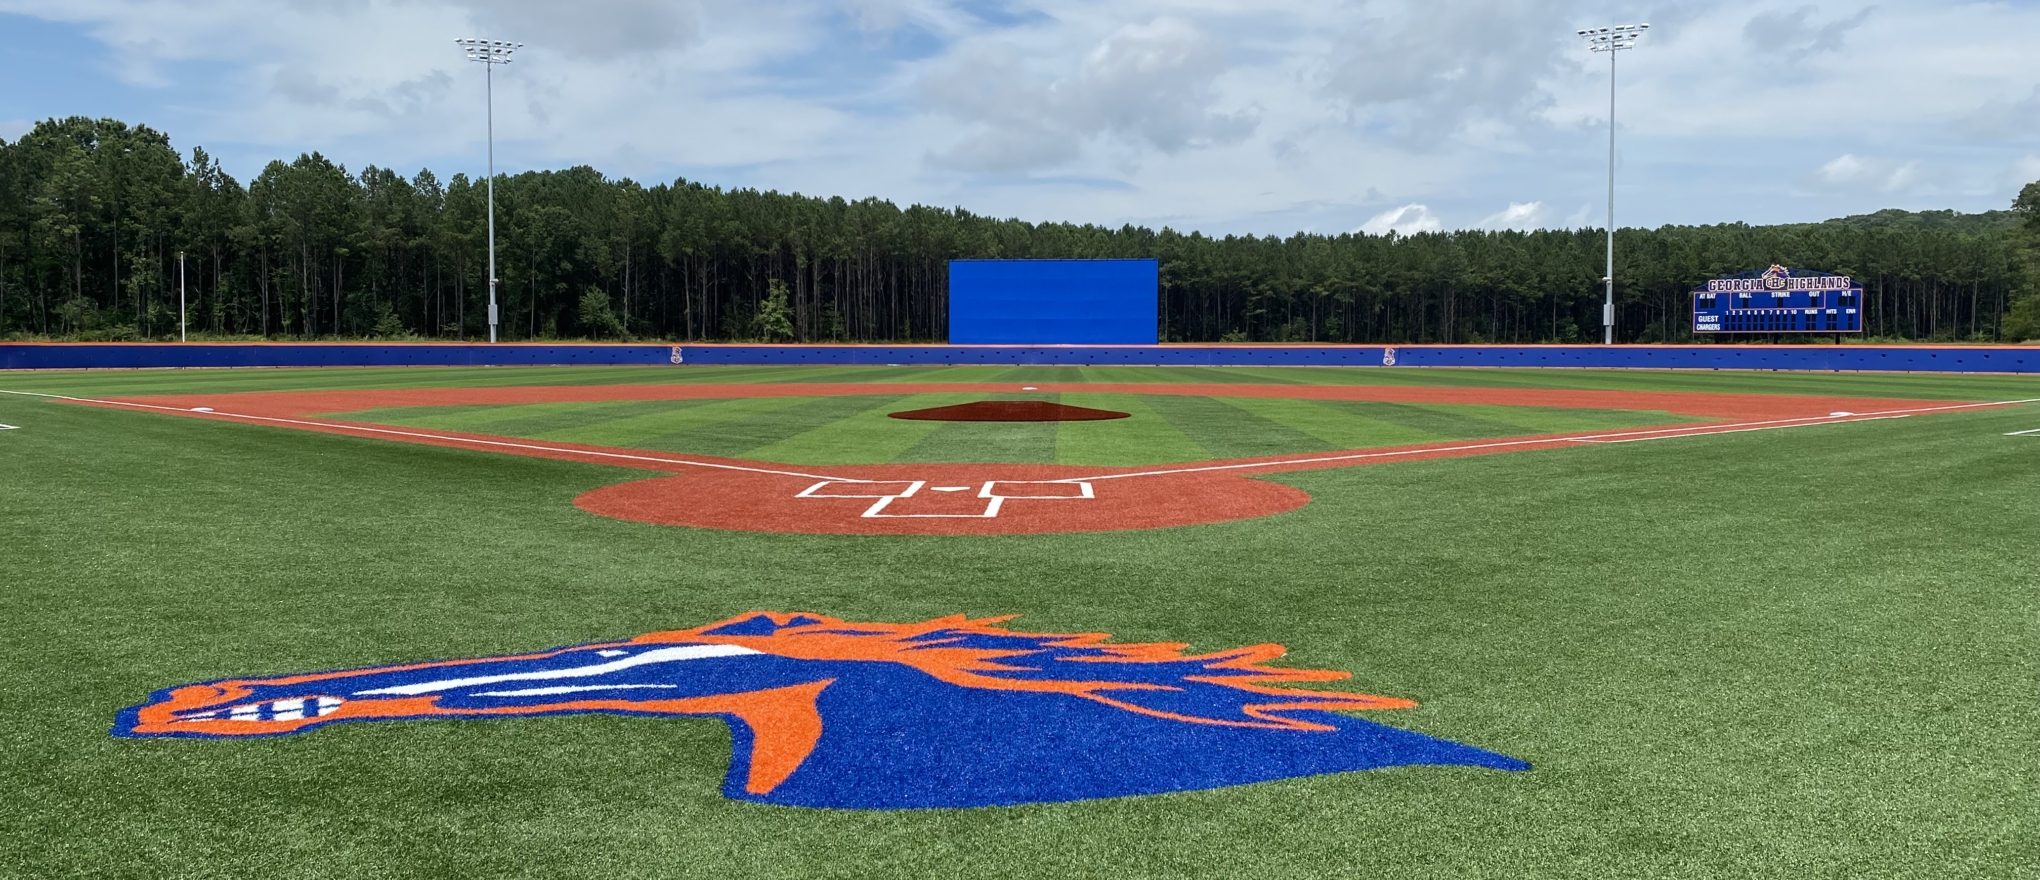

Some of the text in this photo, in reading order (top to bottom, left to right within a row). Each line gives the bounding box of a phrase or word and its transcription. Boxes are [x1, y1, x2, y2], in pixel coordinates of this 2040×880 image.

[1708, 276, 1850, 291] GEORGIA GHC HIGHLANDS
[1698, 315, 1719, 323] GUEST
[1696, 323, 1720, 331] CHARGERS
